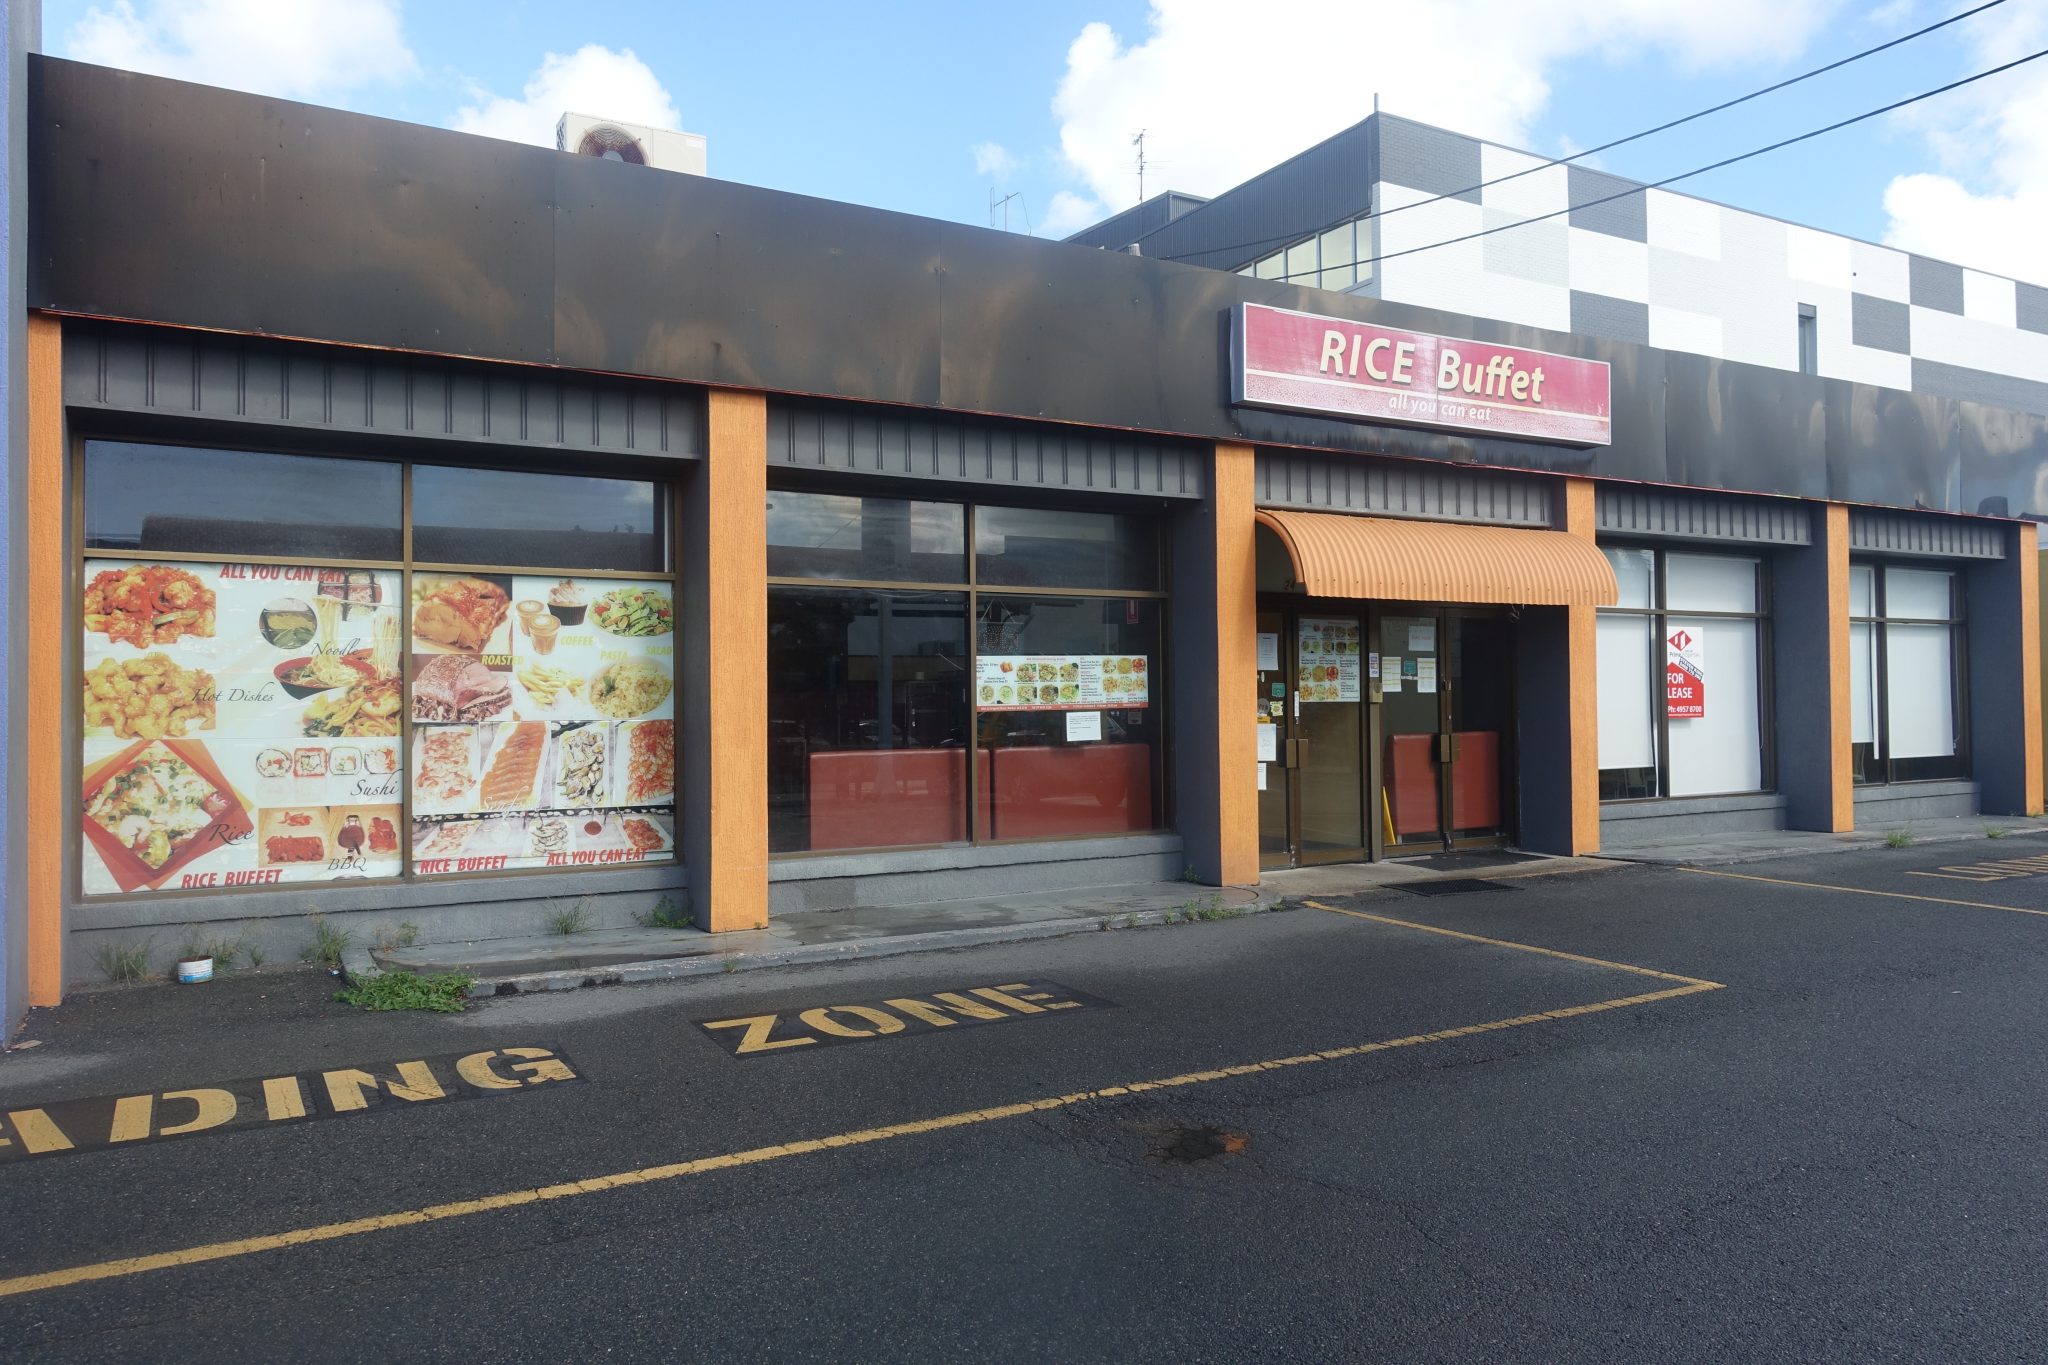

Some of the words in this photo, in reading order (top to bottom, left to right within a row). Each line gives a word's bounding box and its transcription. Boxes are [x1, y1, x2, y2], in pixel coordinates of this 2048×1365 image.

[1319, 330, 1417, 385] RICE
[1437, 348, 1546, 403] Buffet
[1388, 394, 1408, 411] all
[1411, 399, 1436, 416] you
[1441, 402, 1466, 418] can
[1469, 406, 1492, 421] eat
[219, 564, 247, 579] ALL
[250, 565, 281, 580] YOU
[284, 567, 314, 582] CAN
[317, 568, 345, 583] EAT
[311, 638, 360, 656] Noodle
[560, 635, 594, 647] COFFEE
[480, 655, 525, 667] ROASTED
[601, 650, 630, 661] PASTA
[1667, 673, 1684, 684] FOR
[191, 687, 223, 703] Hot
[228, 681, 275, 703] Dishes
[1667, 687, 1693, 698] LEASE
[350, 779, 398, 797] Sushi
[207, 823, 254, 846] Rice
[327, 857, 367, 872] BBQ
[420, 858, 450, 874] RICE
[457, 855, 507, 872] BUFFET
[546, 851, 568, 866] ALL
[572, 850, 595, 864] YOU
[599, 849, 622, 863] CAN
[625, 847, 648, 862] EAT
[181, 872, 217, 889] RICE
[224, 868, 283, 887] BUFFET
[702, 983, 1083, 1054] ZONE
